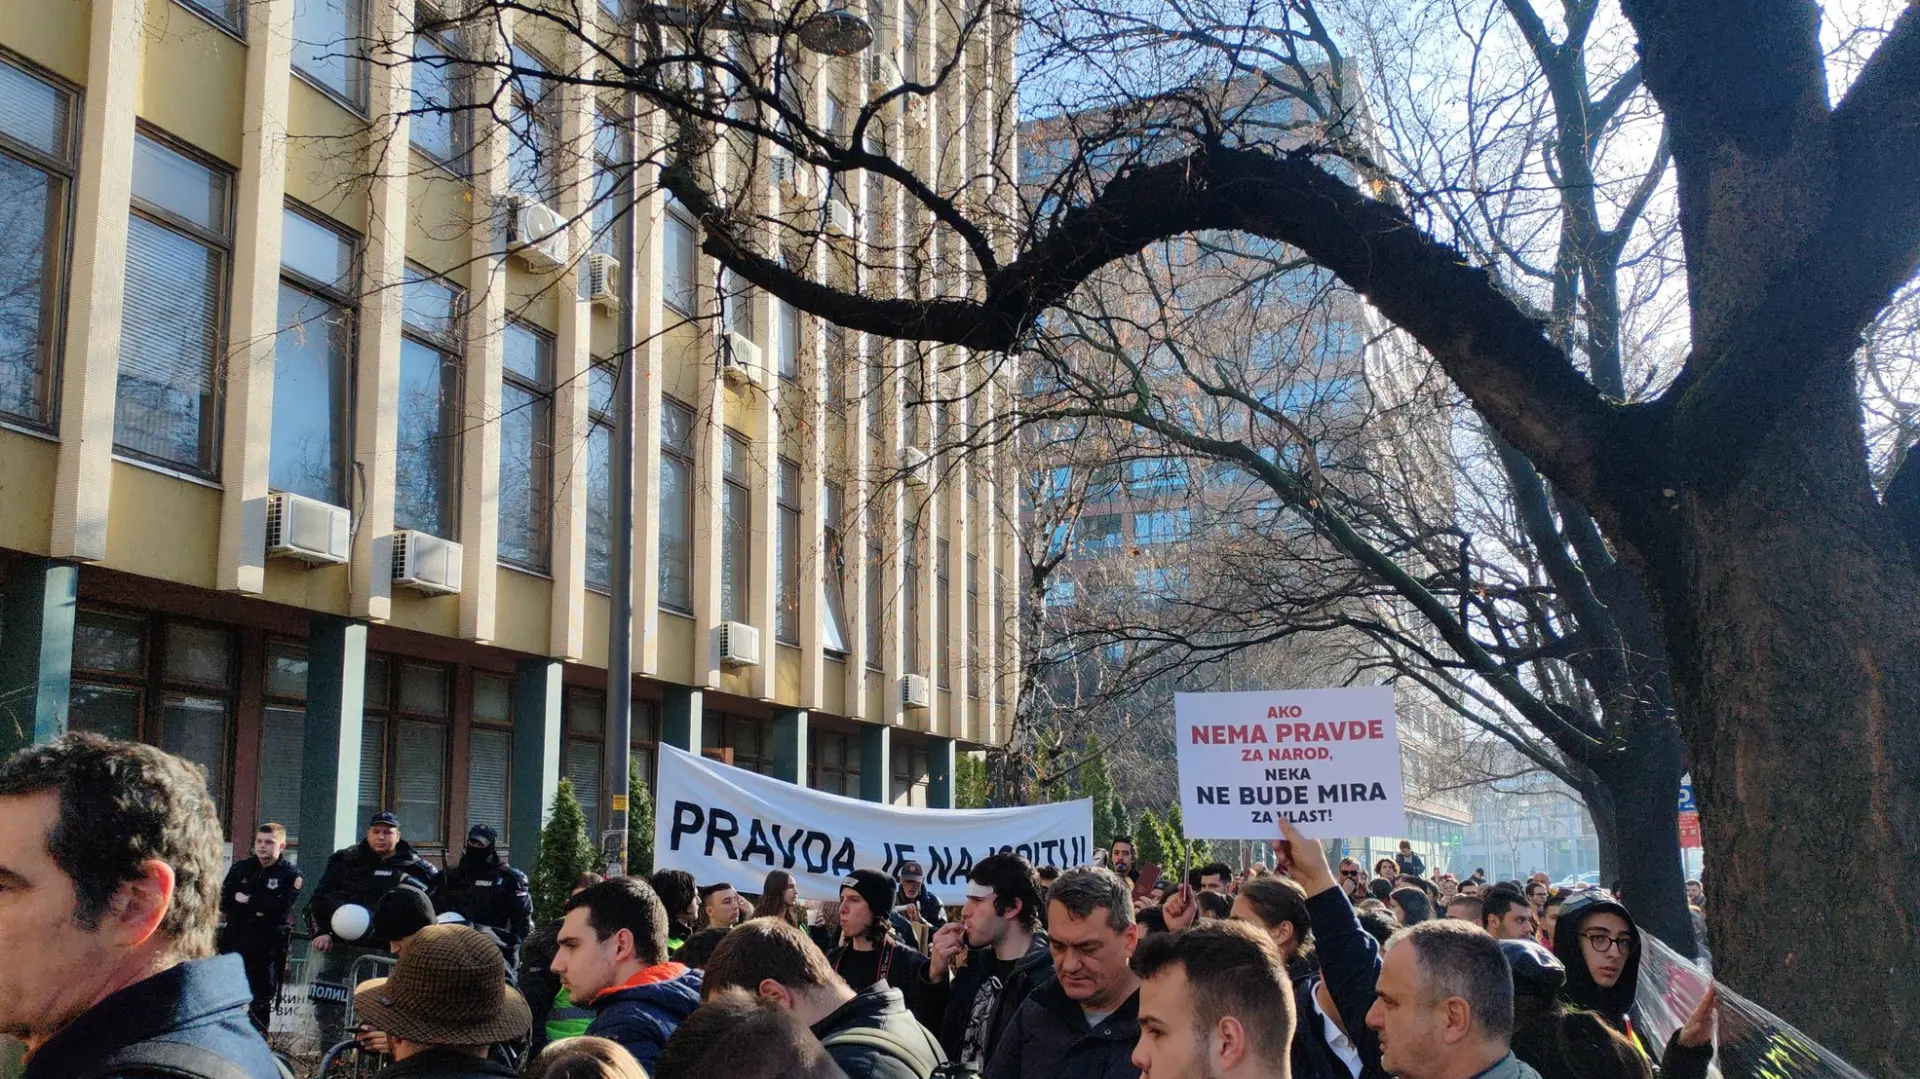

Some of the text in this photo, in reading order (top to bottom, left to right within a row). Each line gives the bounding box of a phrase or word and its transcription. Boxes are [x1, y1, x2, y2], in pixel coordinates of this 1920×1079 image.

[1267, 706, 1302, 719] AKO
[1191, 720, 1384, 745] NEMA PRAVDE
[1241, 746, 1333, 762] ZA NAROD,
[1264, 768, 1311, 781] NEKA
[1196, 782, 1387, 805] NE BUDE MIRA
[1251, 811, 1273, 823] ZA
[670, 800, 855, 876] PRAVDA
[926, 846, 972, 885] NA
